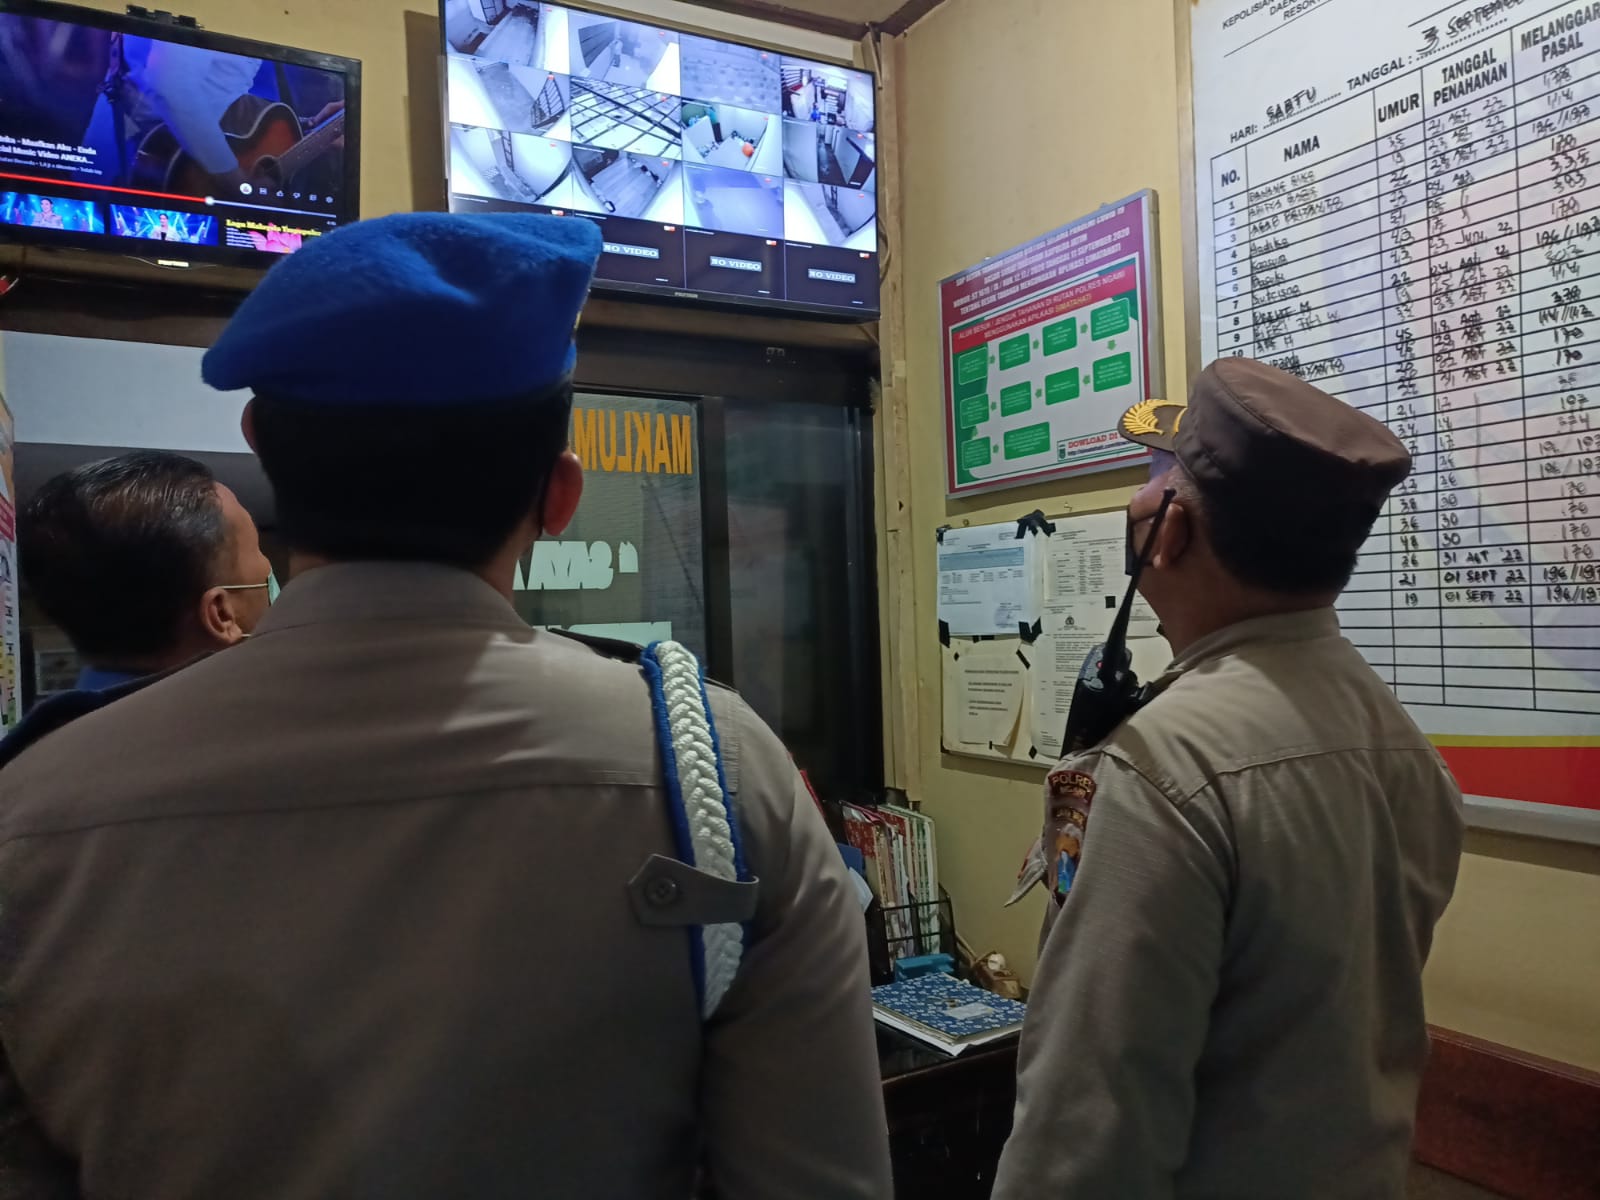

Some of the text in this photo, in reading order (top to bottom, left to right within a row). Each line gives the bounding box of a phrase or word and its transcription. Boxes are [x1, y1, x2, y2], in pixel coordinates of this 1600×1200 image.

[1520, 2, 1600, 51] MELANGGAR
[1541, 31, 1583, 62] PASAL
[1442, 48, 1497, 84] TANGGAL
[1433, 62, 1508, 107] PENAHANAN
[1378, 93, 1420, 123] UMUR
[1283, 135, 1321, 163] NAMA
[1221, 169, 1240, 187] NO.
[1229, 217, 1235, 226] 2
[1230, 234, 1236, 243] 3
[623, 246, 658, 257] VIDEO
[1230, 250, 1237, 259] 4
[730, 260, 761, 271] VIDEO
[1231, 267, 1238, 276] 5
[826, 273, 855, 282] VIDEO
[1232, 283, 1239, 292] 6
[1232, 300, 1239, 309] 7
[1233, 316, 1240, 326] 8
[1233, 333, 1240, 342] 9
